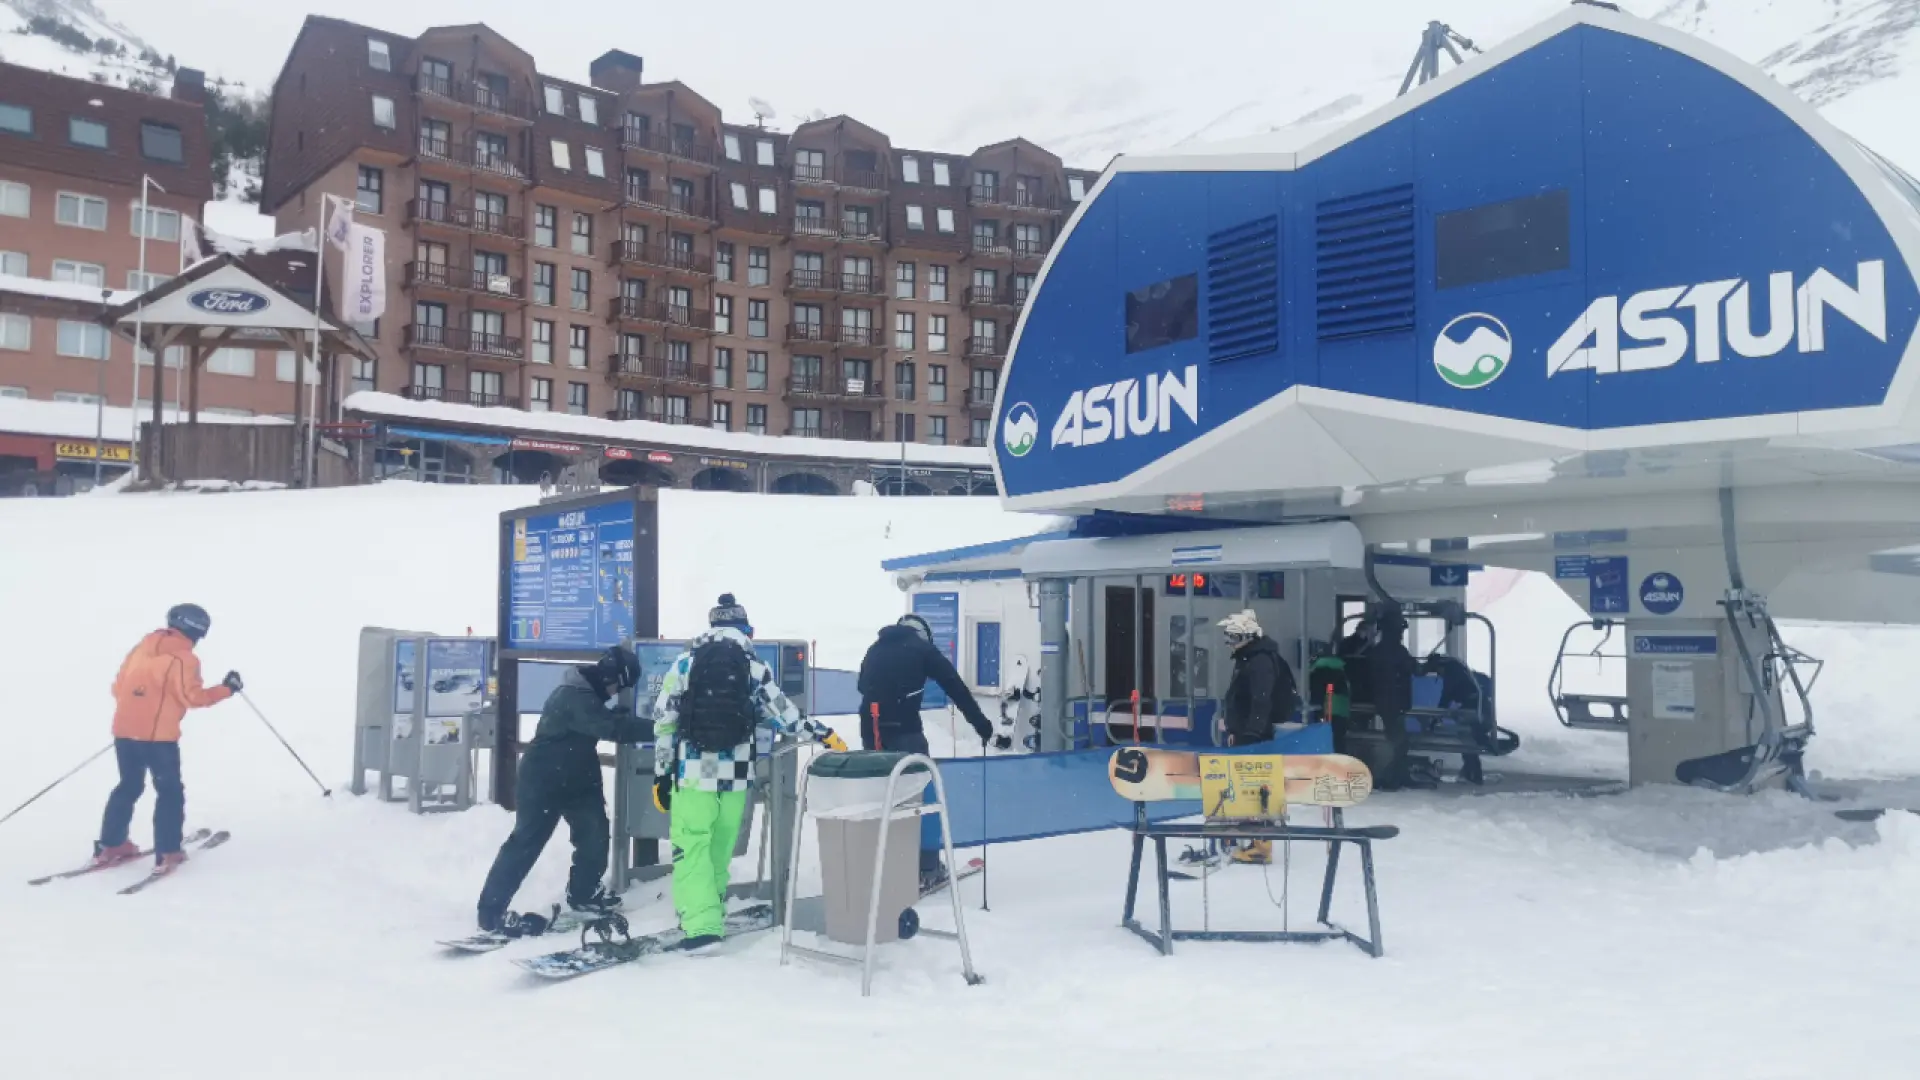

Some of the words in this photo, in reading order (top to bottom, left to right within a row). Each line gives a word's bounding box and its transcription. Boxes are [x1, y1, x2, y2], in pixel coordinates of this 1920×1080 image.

[203, 291, 252, 311] Ford
[359, 236, 373, 315] EXPLORER
[1547, 259, 1886, 380] ASTUN
[1051, 365, 1198, 449] ASTUN
[59, 444, 89, 455] CASA
